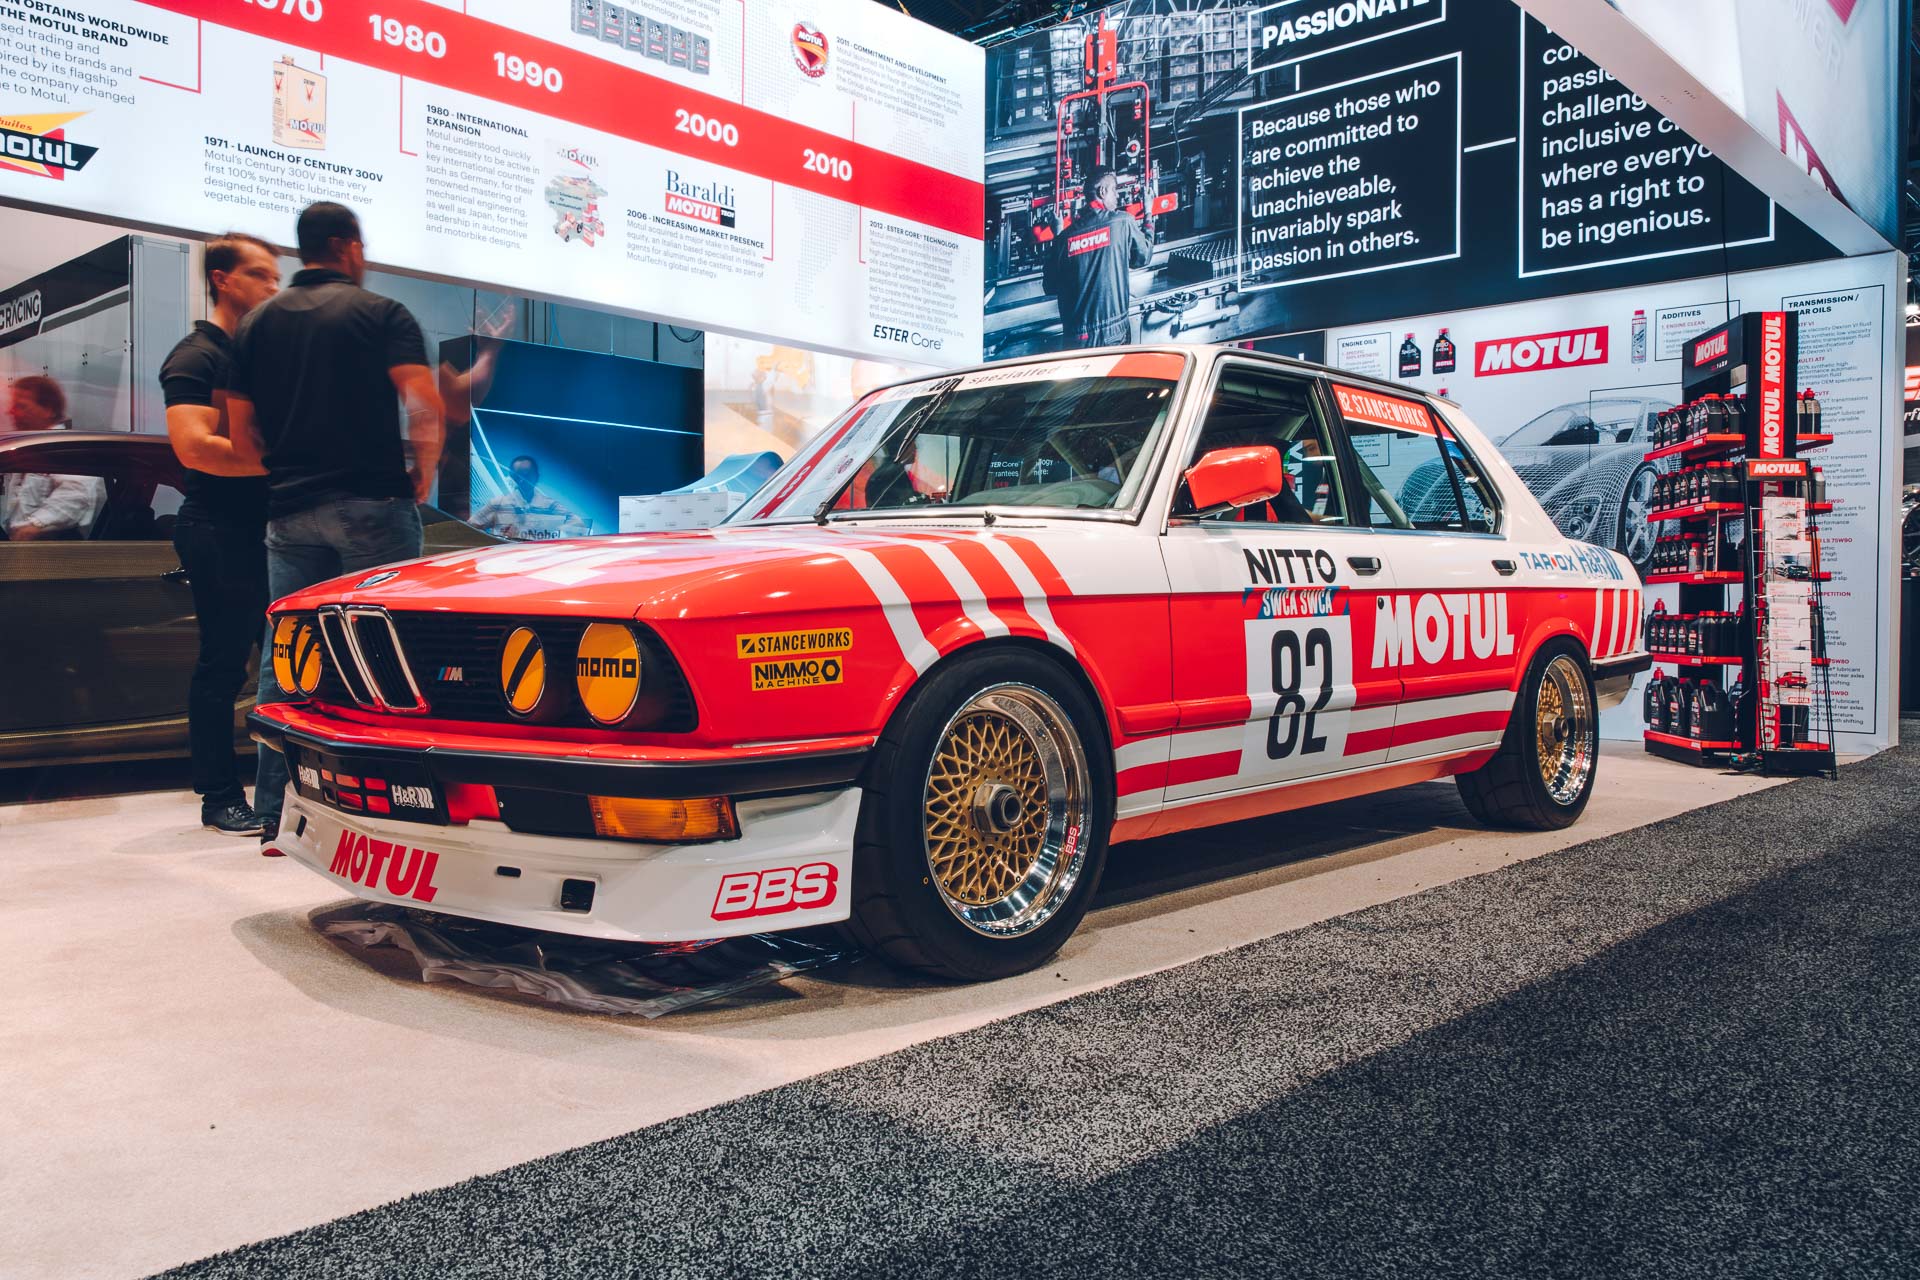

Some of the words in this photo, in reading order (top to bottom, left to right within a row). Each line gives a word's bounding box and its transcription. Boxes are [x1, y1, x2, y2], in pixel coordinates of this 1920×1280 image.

[0, 5, 26, 21] THE
[29, 13, 79, 34] MOTUL
[82, 26, 129, 47] BRAND
[24, 0, 85, 23] OBTAINS
[88, 15, 169, 45] WORLDWIDE
[368, 14, 447, 59] 1980
[15, 41, 36, 53] out
[40, 44, 61, 59] the
[65, 51, 107, 70] brands
[110, 64, 132, 77] and
[28, 28, 73, 51] trading
[77, 43, 100, 55] and
[20, 71, 79, 94] company
[82, 85, 135, 105] changed
[32, 57, 47, 72] by
[51, 61, 66, 73] its
[70, 65, 118, 87] flagship
[493, 51, 563, 93] 1990
[14, 81, 27, 94] to
[31, 85, 70, 104] Motul.
[1252, 108, 1330, 138] Because
[1335, 93, 1390, 119] those
[1395, 80, 1440, 104] who
[1542, 92, 1647, 127] challeng
[427, 105, 449, 118] 1980
[456, 112, 528, 138] INTERNATIONAL
[427, 116, 481, 137] EXPANSION
[674, 108, 739, 147] 2000
[1252, 145, 1281, 164] are
[1284, 116, 1392, 157] committed
[1396, 112, 1418, 133] to
[1542, 122, 1651, 158] inclusive
[204, 136, 229, 149] 1971
[237, 143, 284, 161] LAUNCH
[287, 154, 301, 165] OF
[304, 158, 353, 176] CENTURY
[355, 169, 383, 183] 300V
[244, 158, 285, 177] Century
[288, 167, 316, 181] 300V
[318, 173, 326, 183] is
[329, 175, 344, 187] the
[347, 181, 367, 193] very
[803, 148, 852, 181] 2010
[1252, 163, 1324, 191] achieve
[1328, 154, 1361, 176] the
[1541, 160, 1617, 188] where
[204, 163, 225, 175] first
[228, 167, 257, 181] 100%
[259, 176, 305, 191] synthetic
[307, 183, 356, 201] lubricant
[359, 195, 373, 204] ever
[204, 176, 253, 193] designed
[256, 186, 270, 197] for
[665, 169, 734, 208] Baraldi
[1252, 175, 1397, 218] unachieveable,
[1542, 196, 1582, 219] has
[1589, 194, 1603, 210] a
[1610, 176, 1670, 209] right
[1677, 173, 1705, 195] to
[204, 191, 256, 207] vegetable
[258, 201, 288, 213] esters
[667, 196, 719, 222] MOTUL
[627, 209, 647, 221] 2006
[653, 216, 698, 233] INCREASING
[700, 227, 728, 240] MARKET
[729, 234, 764, 249] PRESENCE
[886, 225, 904, 235] ESTER
[1251, 212, 1342, 245] invariably
[1346, 200, 1403, 231] spark
[1542, 227, 1571, 249] be
[1578, 209, 1710, 245] ingenious.
[1069, 231, 1109, 252] MOTUL
[1252, 244, 1321, 276] passion
[1327, 238, 1344, 259] in
[1349, 231, 1420, 255] others.
[1662, 310, 1702, 320] ADDITIVES
[1788, 294, 1854, 308] TRANSMISSION
[1812, 306, 1832, 314] OILS
[873, 324, 909, 343] ESTER
[1341, 340, 1363, 348] ENGINE
[1695, 334, 1727, 363] MOTUL
[1765, 317, 1781, 384] MOTUL
[1480, 332, 1603, 373] MOTUL
[1352, 396, 1428, 428] STANCEWORKS
[1764, 388, 1780, 455] MOTUL
[1754, 463, 1802, 474] MOTUL
[1242, 548, 1337, 585] NITTO
[1262, 591, 1298, 617] SWCA
[1299, 589, 1334, 615] SWCA
[758, 631, 850, 653] STANCEWORKS
[1370, 592, 1515, 669] MOTUL
[577, 658, 637, 679] momo
[754, 660, 819, 681] NIMMO
[755, 677, 820, 689] MACHINE
[1266, 627, 1334, 760] 82
[1065, 827, 1077, 854] BBS
[329, 829, 440, 903] MOTUL
[711, 861, 839, 921] BBS
